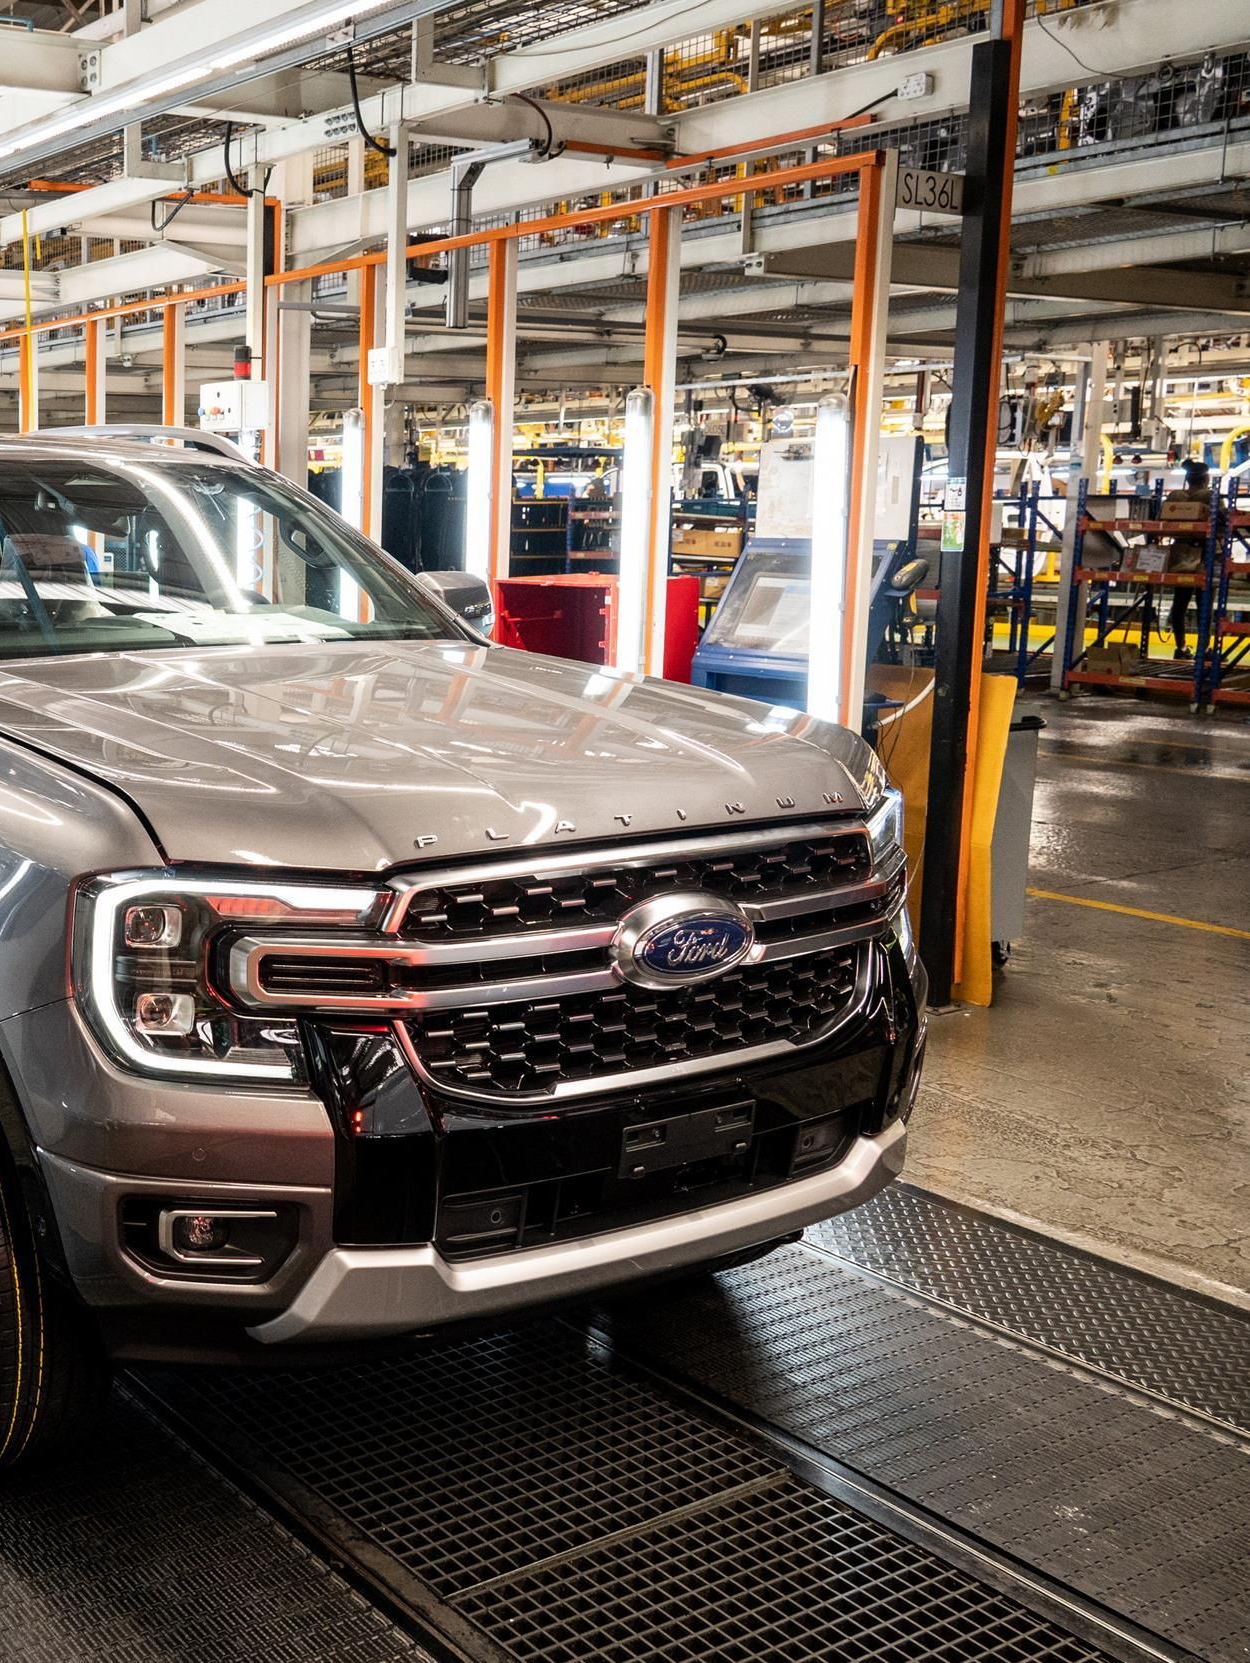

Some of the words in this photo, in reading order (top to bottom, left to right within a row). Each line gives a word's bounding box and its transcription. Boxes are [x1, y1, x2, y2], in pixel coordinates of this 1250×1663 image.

[902, 173, 958, 210] SL36L
[414, 791, 844, 849] PLATINUM
[668, 928, 730, 967] Ford
